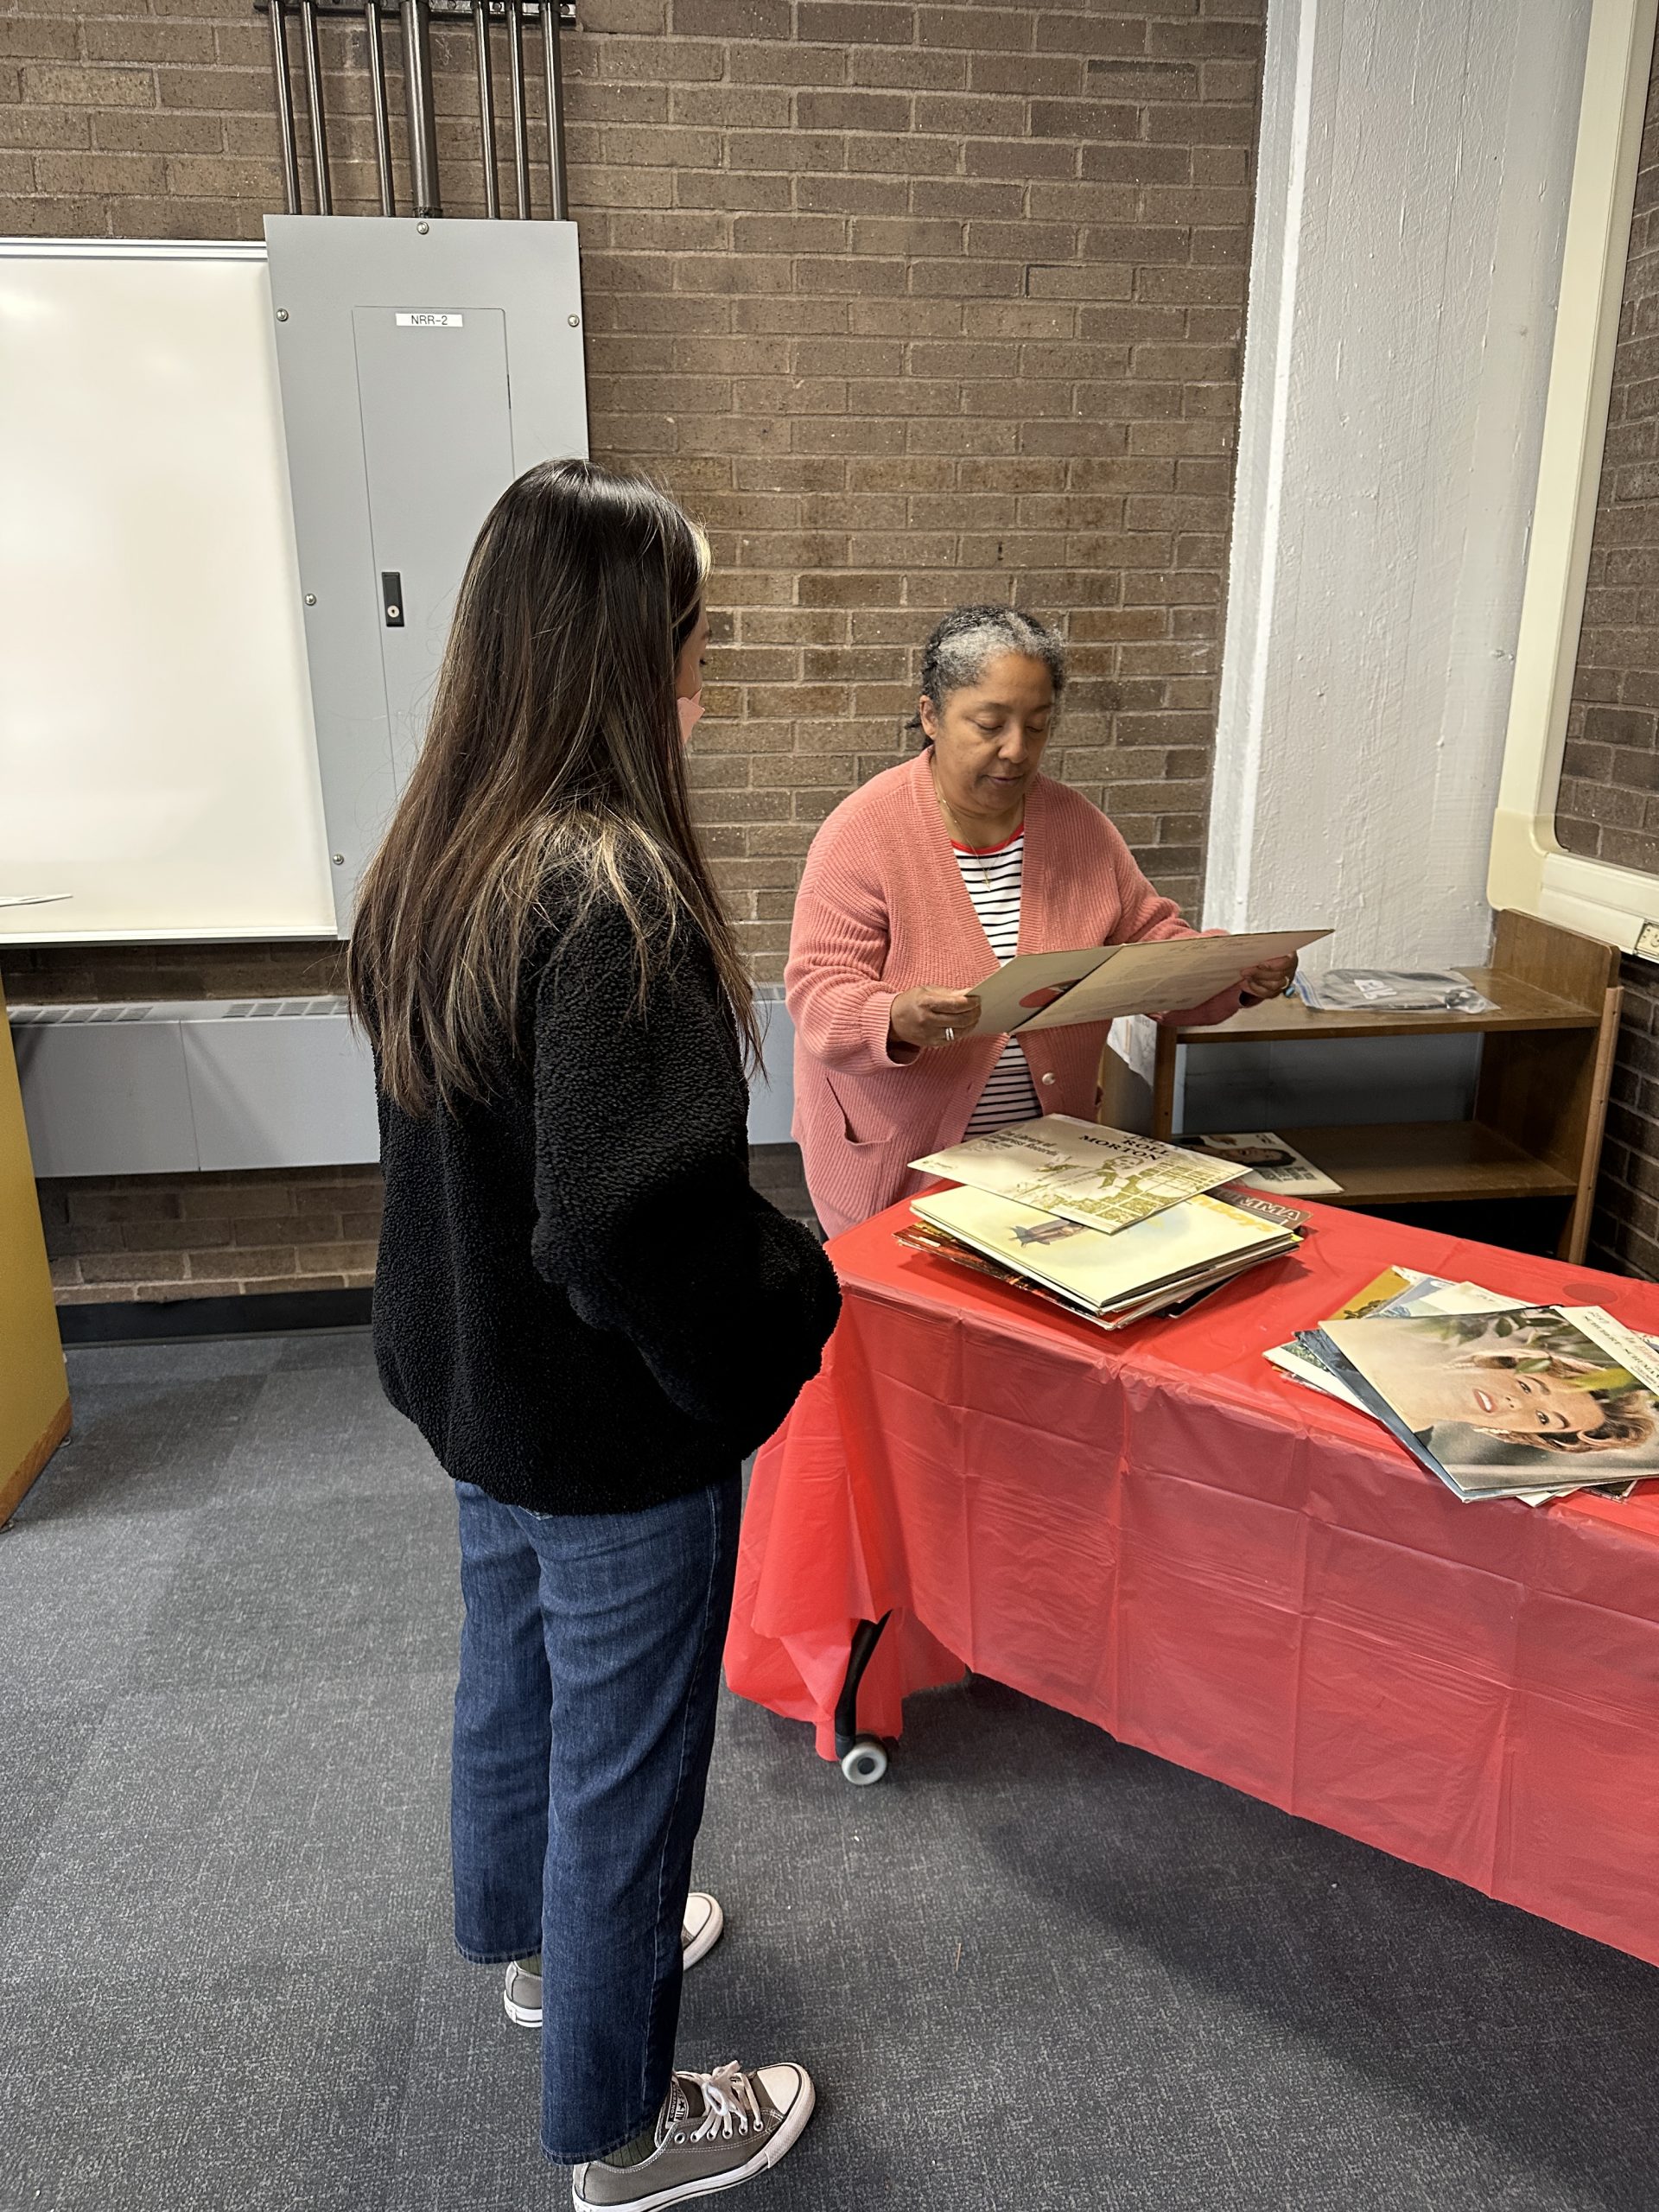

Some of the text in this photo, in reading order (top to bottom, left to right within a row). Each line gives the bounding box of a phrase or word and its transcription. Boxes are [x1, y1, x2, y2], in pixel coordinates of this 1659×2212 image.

[411, 315, 448, 325] NRR-2
[1078, 1135, 1162, 1160] MORTON
[1121, 1140, 1171, 1156] ROLL
